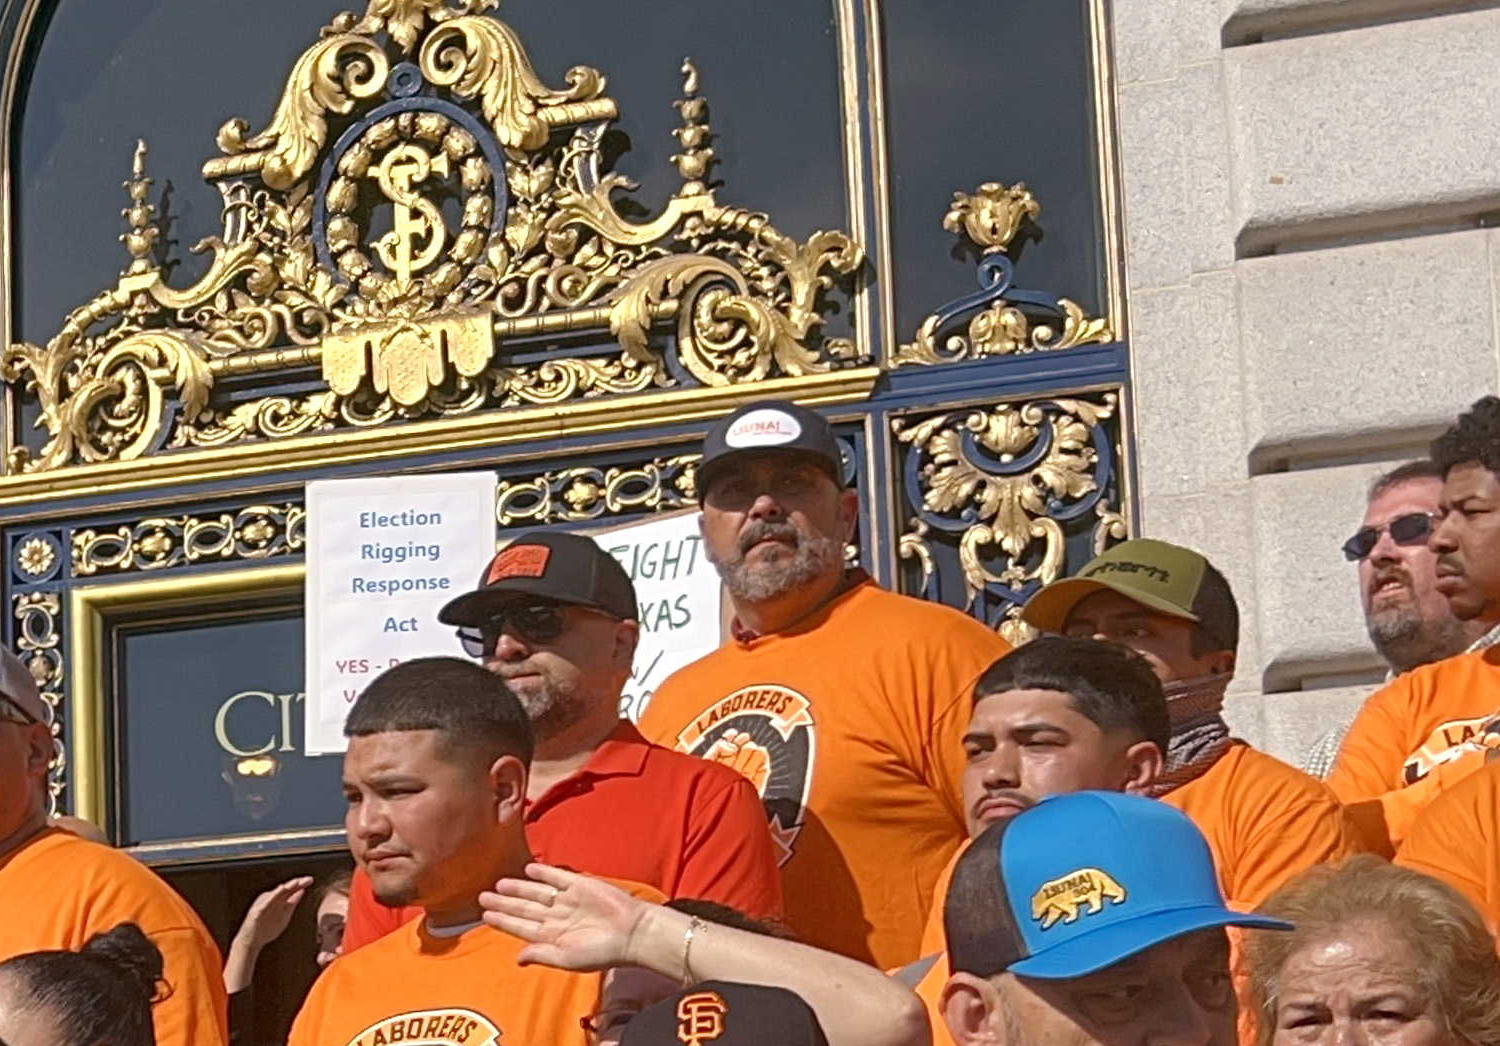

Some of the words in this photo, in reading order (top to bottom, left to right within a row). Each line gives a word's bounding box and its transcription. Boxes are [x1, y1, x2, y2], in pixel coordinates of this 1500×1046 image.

[359, 509, 442, 528] Election
[361, 541, 440, 563] Rigging
[352, 576, 451, 596] Response
[383, 616, 419, 632] Act
[335, 659, 369, 674] YES
[696, 690, 793, 735] LABORERS
[214, 690, 306, 757] CI
